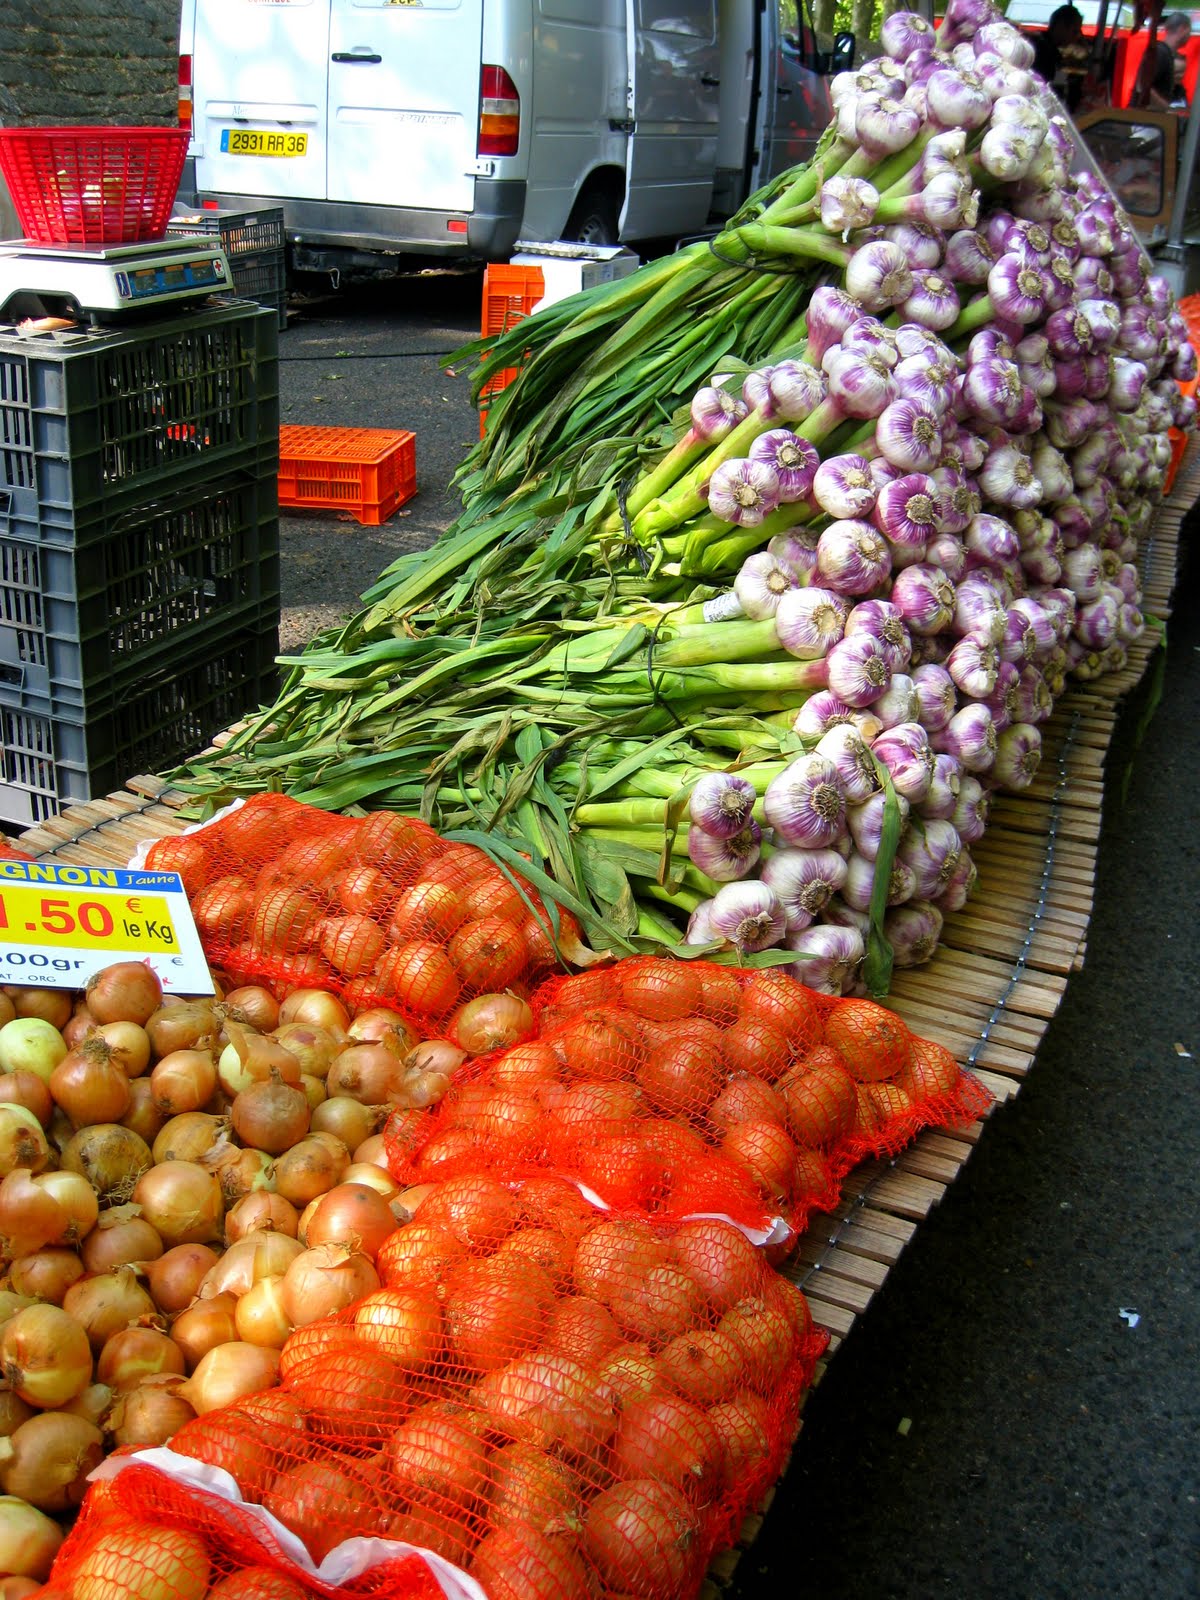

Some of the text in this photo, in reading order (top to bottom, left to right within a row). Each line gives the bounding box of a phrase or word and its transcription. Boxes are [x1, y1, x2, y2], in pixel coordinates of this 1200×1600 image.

[232, 133, 305, 152] 2931 RR 36
[125, 874, 176, 886] Jaune
[126, 898, 143, 913] €
[123, 919, 174, 944] le Kg
[171, 957, 184, 966] €
